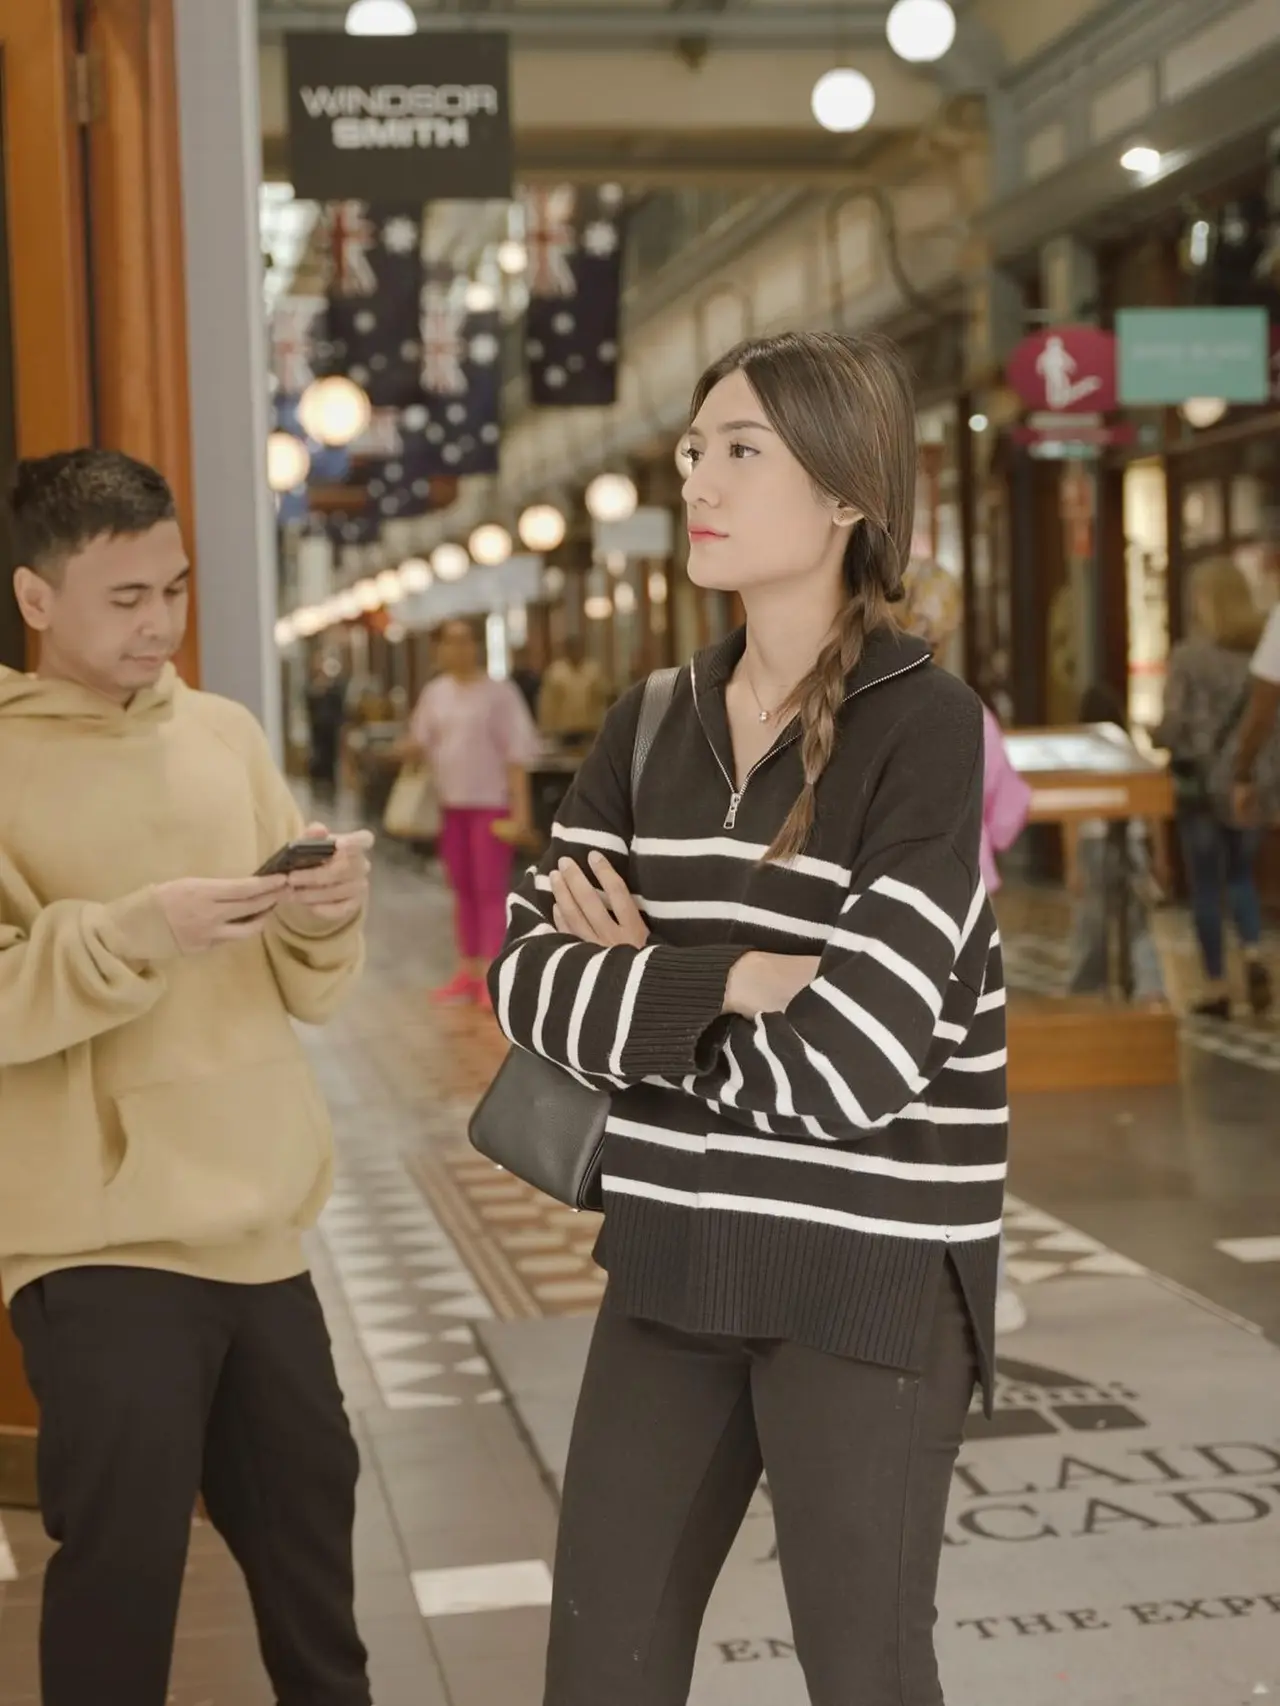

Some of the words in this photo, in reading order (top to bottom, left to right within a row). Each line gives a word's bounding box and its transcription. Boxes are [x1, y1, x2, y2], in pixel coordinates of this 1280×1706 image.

[300, 84, 498, 118] WINDSOR
[332, 117, 468, 149] SMITH
[953, 1440, 1280, 1498] LAID
[943, 1484, 1280, 1546] CAD
[955, 1607, 1111, 1640] THE
